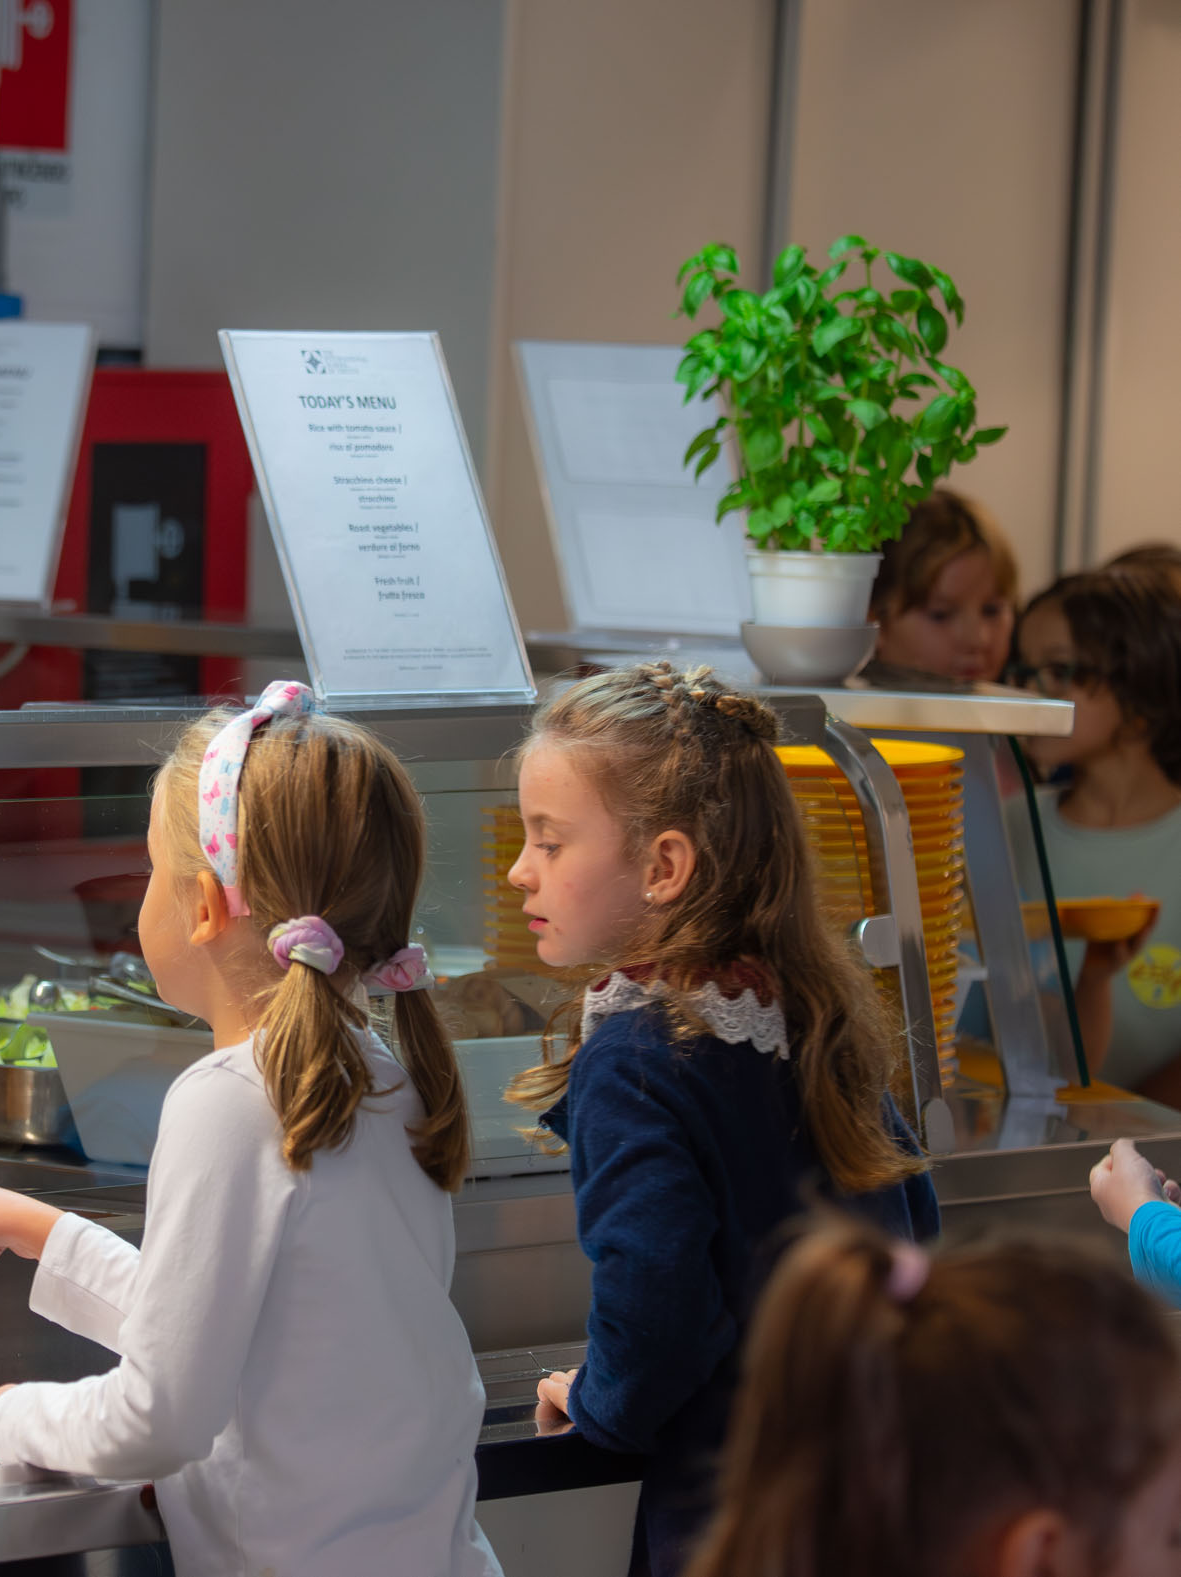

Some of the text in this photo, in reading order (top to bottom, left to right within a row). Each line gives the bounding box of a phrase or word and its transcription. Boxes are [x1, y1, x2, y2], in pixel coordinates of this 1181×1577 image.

[298, 395, 397, 410] TODAY'S MENU
[308, 424, 325, 432] Rice
